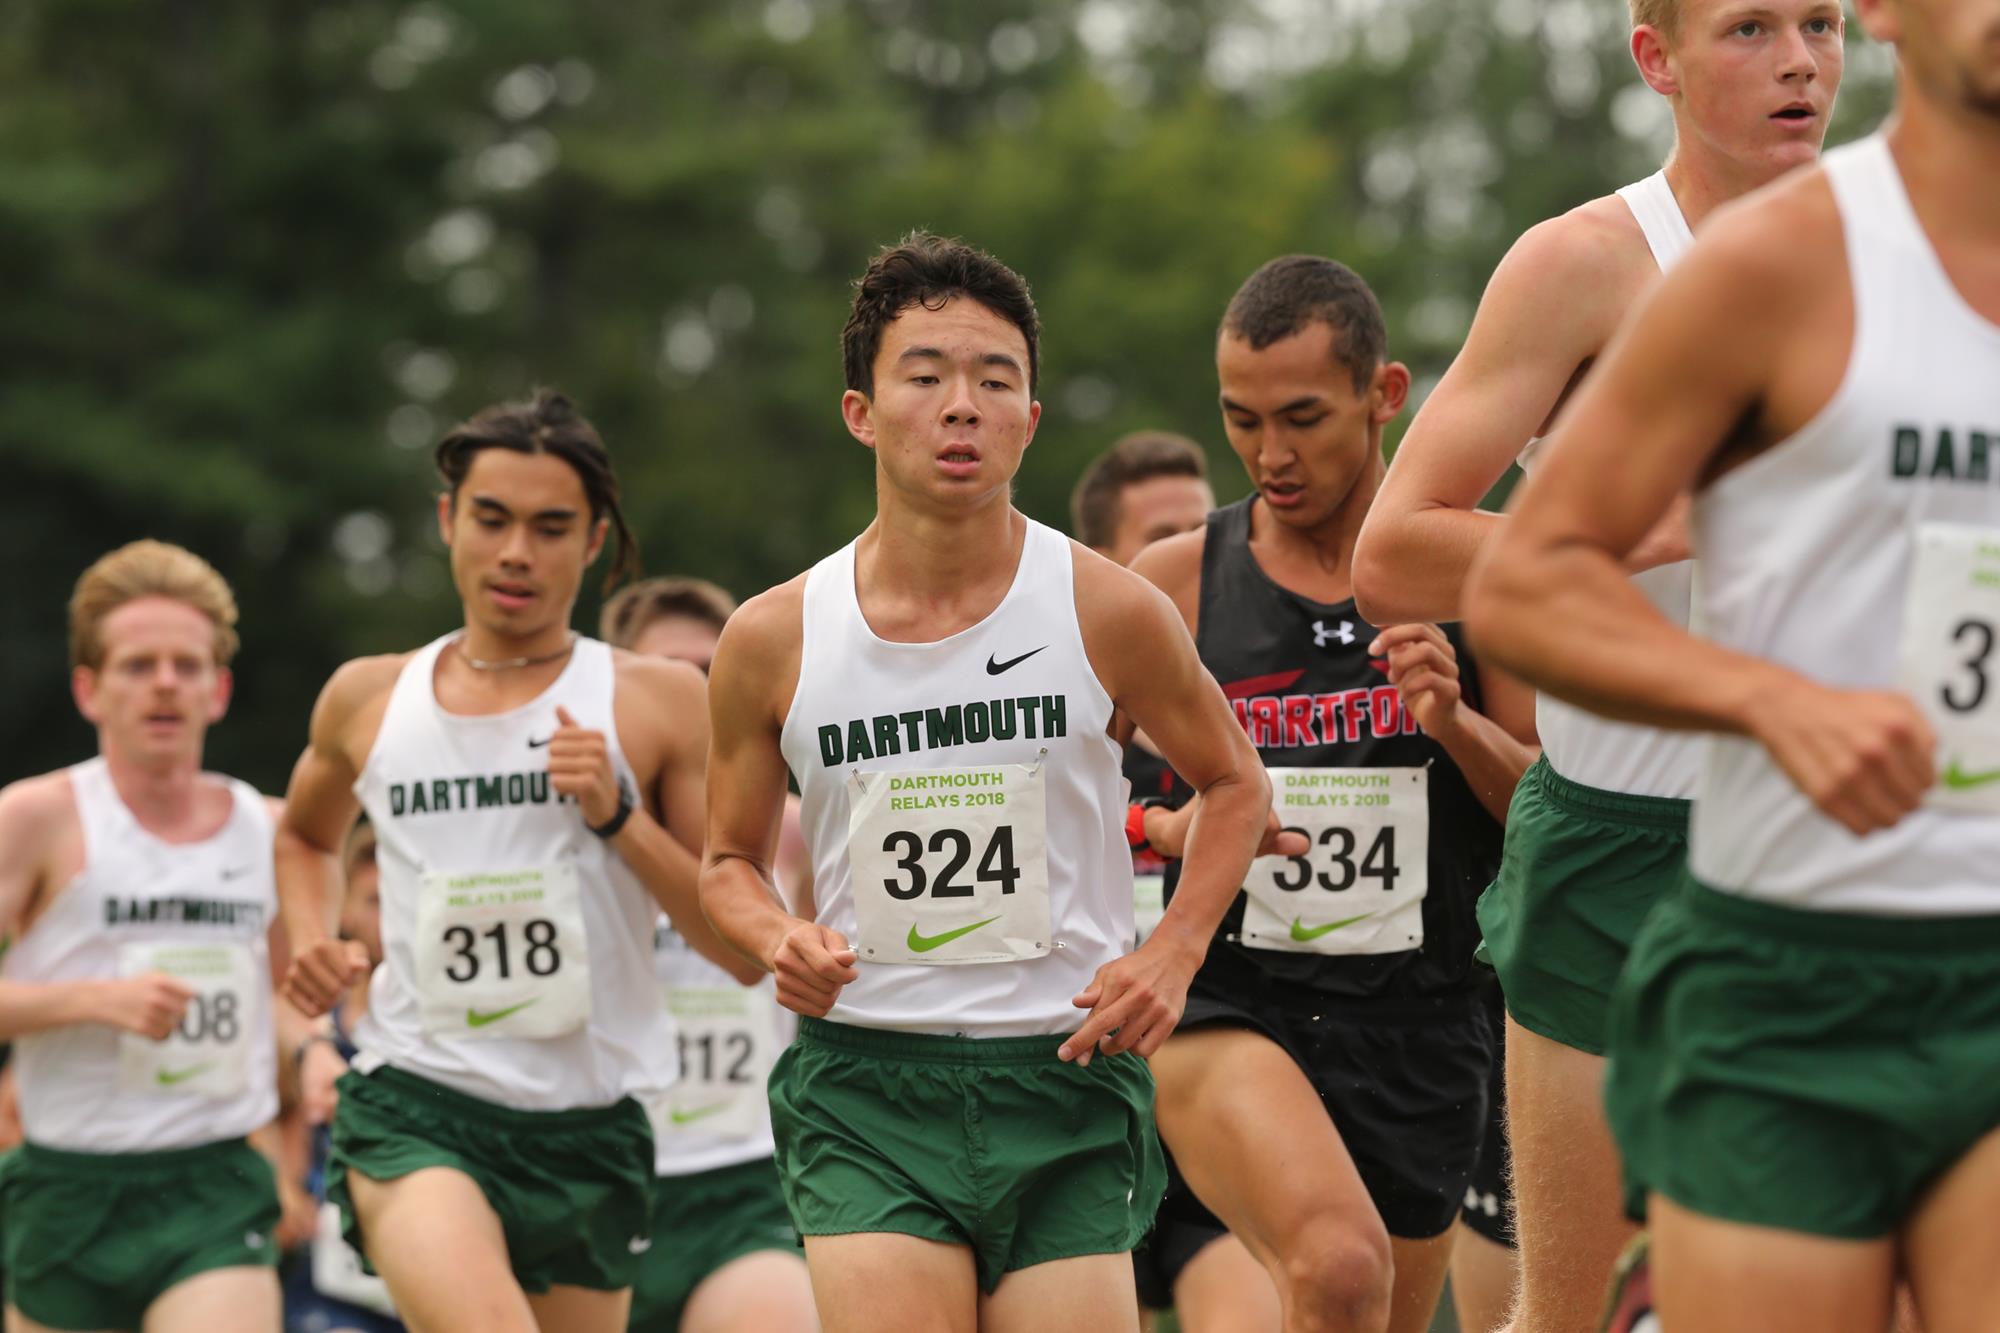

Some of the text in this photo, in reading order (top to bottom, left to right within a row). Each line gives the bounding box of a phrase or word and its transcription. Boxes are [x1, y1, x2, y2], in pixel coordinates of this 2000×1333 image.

[818, 695, 1067, 767] DARTMOUTH
[1231, 685, 1418, 747] ARTFO
[390, 771, 579, 817] DARTMOU
[890, 773, 1004, 790] DARTMOUTH
[891, 792, 1005, 811] RELAYS 2018
[1284, 793, 1391, 807] RELAYS 2018
[1285, 775, 1391, 788] DARTMOUTH
[882, 825, 1021, 900] 324
[442, 919, 561, 982] 318
[177, 989, 239, 1043] 08
